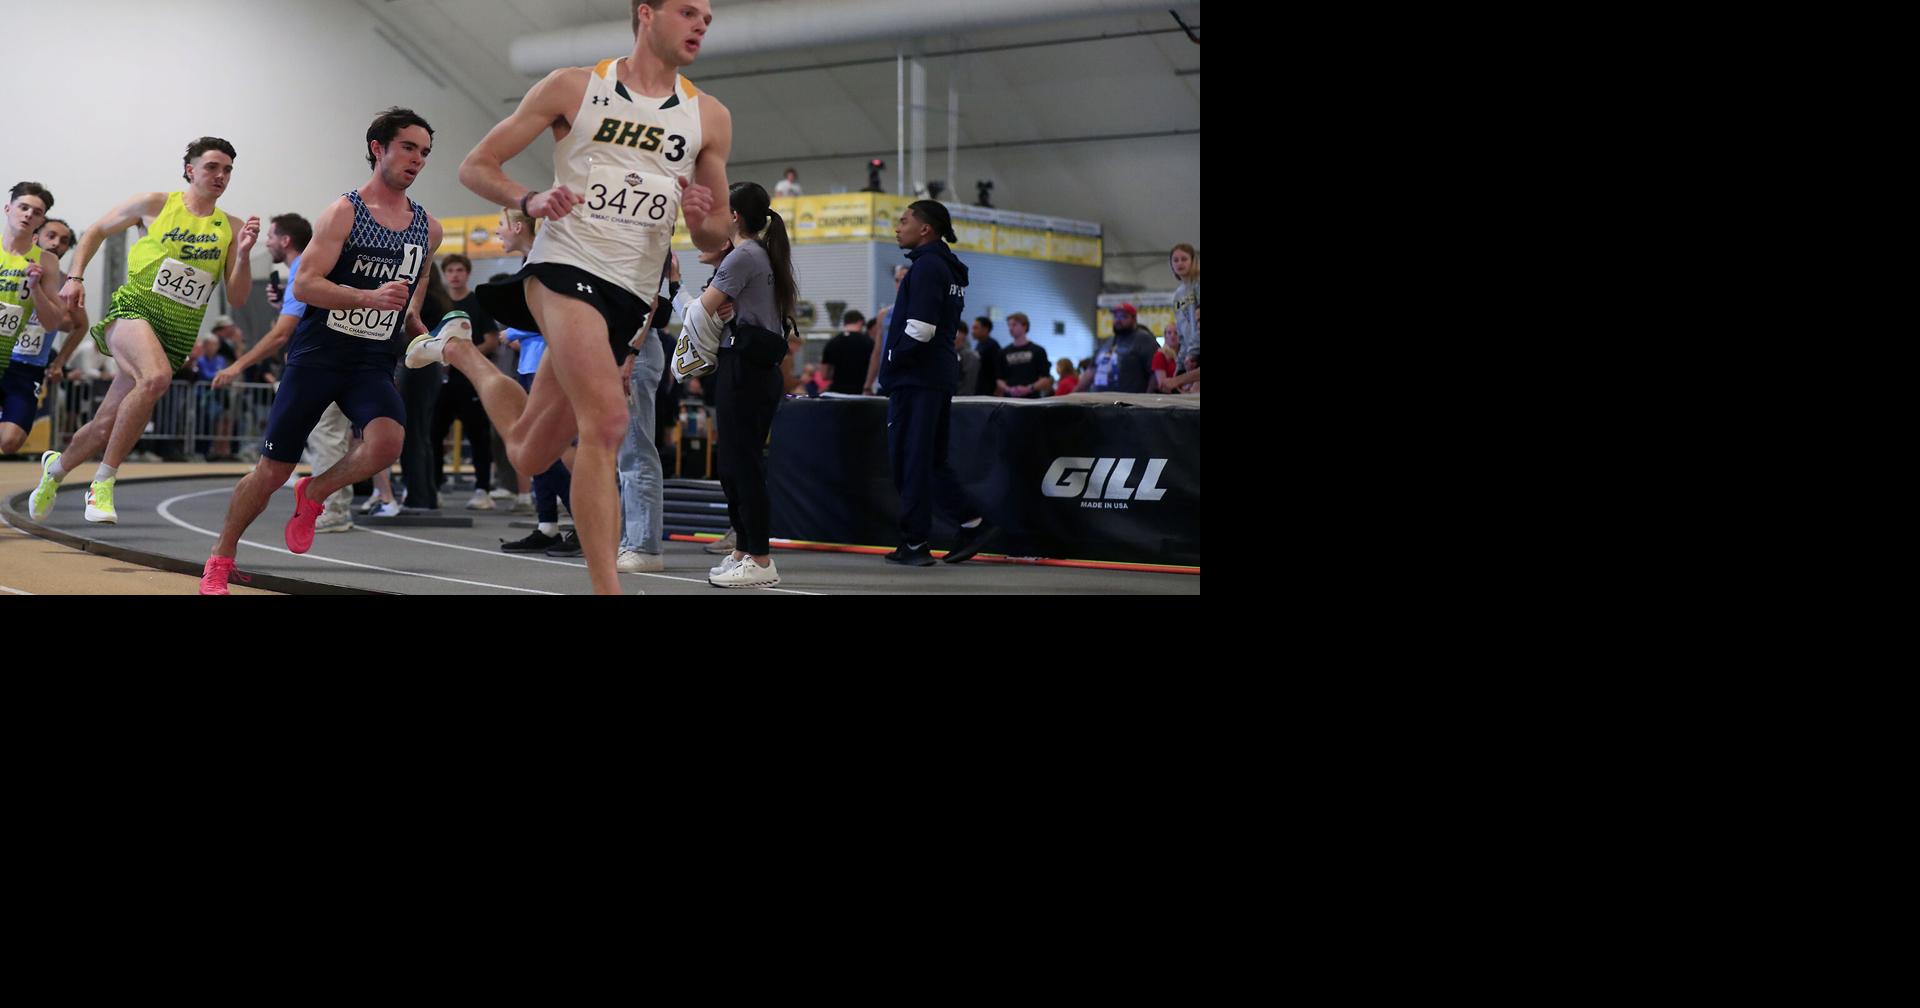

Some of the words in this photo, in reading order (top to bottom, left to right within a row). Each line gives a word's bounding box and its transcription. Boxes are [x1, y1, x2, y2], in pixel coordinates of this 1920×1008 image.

[592, 118, 664, 153] BHS
[665, 134, 686, 162] 3
[587, 183, 667, 221] 3478
[161, 227, 218, 243] Adams
[180, 245, 221, 260] State
[357, 254, 394, 264] COLORADO
[409, 247, 418, 274] 1
[20, 280, 30, 300] 5
[157, 269, 206, 300] 3451
[0, 314, 19, 330] 48
[349, 327, 385, 338] CHAMPIONSHIP
[1041, 456, 1169, 501] GILL
